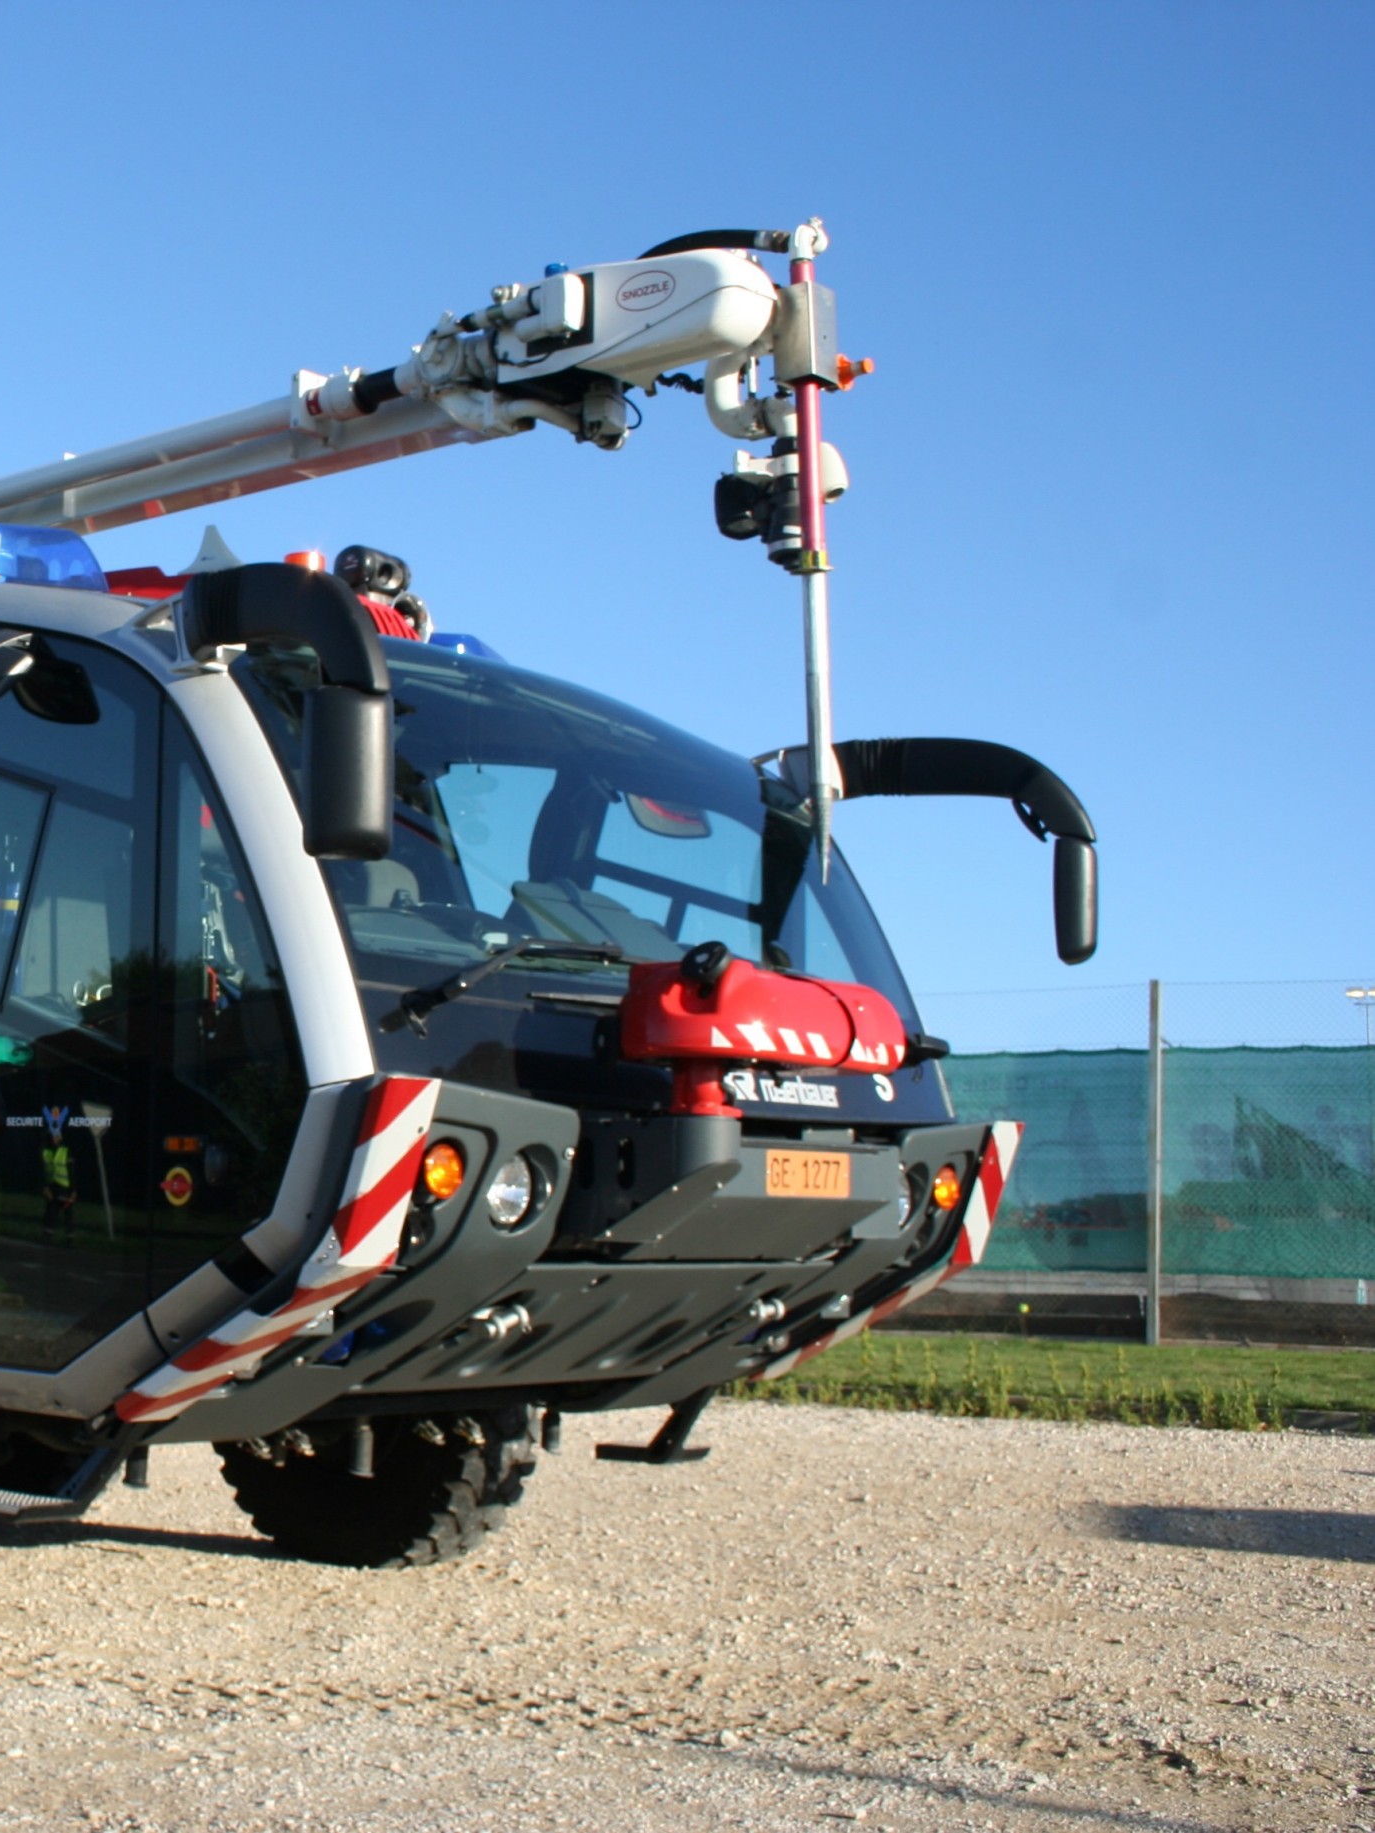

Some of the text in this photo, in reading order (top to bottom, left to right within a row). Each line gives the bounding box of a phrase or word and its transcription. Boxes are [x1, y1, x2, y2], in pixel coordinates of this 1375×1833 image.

[621, 280, 670, 301] SNOZZLE
[6, 1116, 113, 1128] SECURITE AEROPORT
[802, 1160, 842, 1191] 1277
